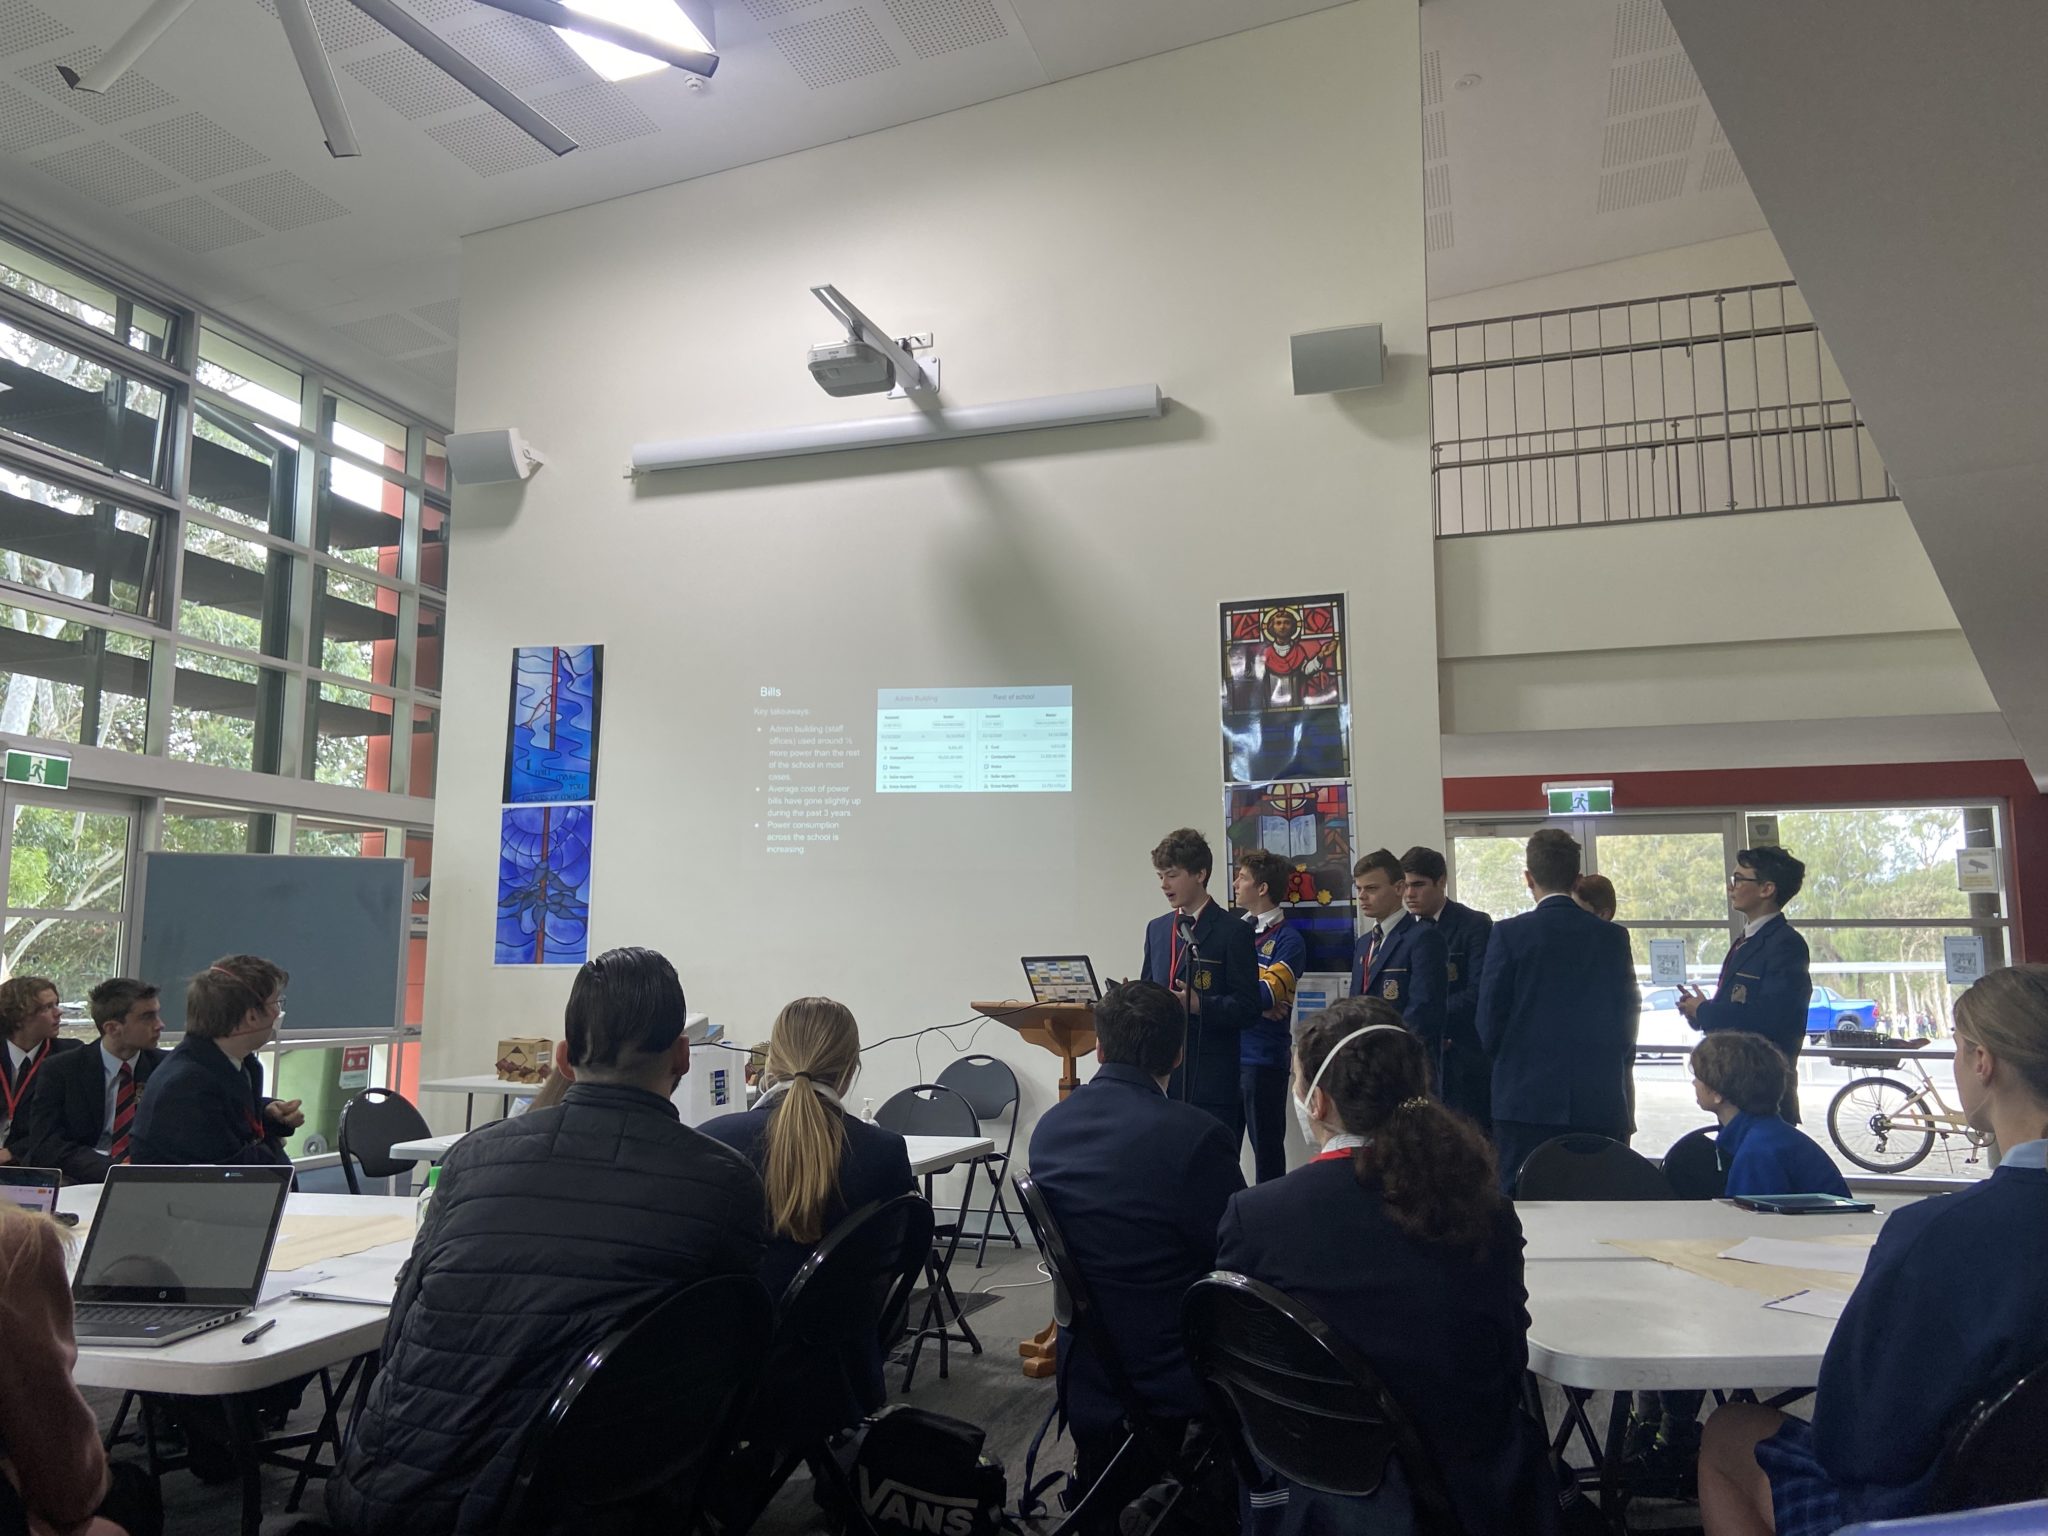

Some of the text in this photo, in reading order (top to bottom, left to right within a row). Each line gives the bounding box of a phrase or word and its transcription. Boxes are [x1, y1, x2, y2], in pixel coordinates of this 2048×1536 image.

[760, 686, 782, 697] Bills
[769, 724, 794, 734] Admin
[794, 724, 823, 735] building
[768, 736, 797, 746] offices)
[798, 736, 816, 745] used
[817, 736, 844, 745] around
[768, 748, 861, 759] more power than the rest
[525, 759, 532, 771] I
[768, 760, 844, 769] of the school in most
[768, 785, 850, 794] Average cost of power
[767, 797, 862, 806] bills have gone slightly up
[767, 809, 791, 819] during
[792, 809, 805, 817] the
[806, 809, 823, 818] past
[824, 809, 830, 817] 3
[767, 821, 840, 830] Power consumption
[766, 832, 840, 841] across the school is
[858, 1464, 978, 1536] VANS
